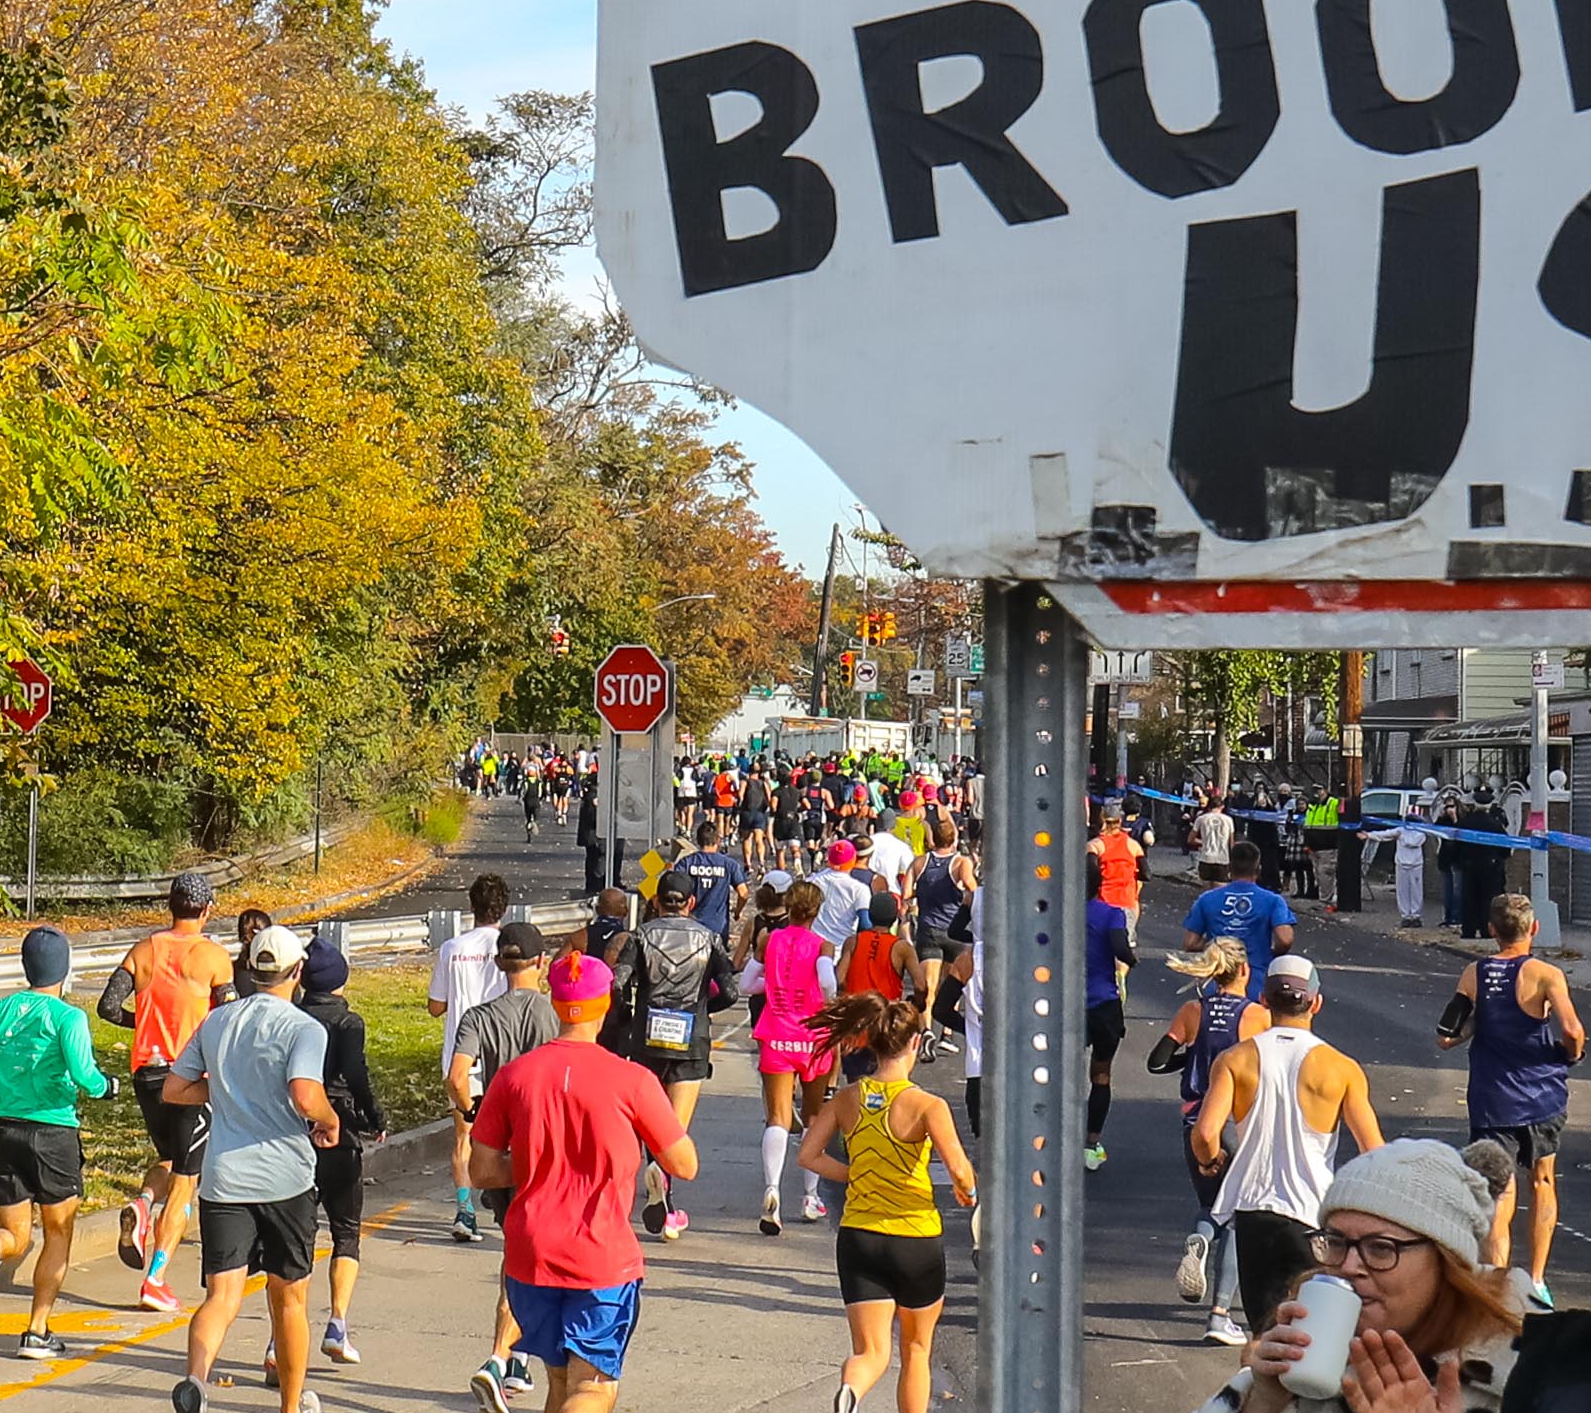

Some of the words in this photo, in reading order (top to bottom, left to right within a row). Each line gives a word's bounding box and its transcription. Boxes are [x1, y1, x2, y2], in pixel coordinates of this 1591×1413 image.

[948, 652, 965, 664] 25
[602, 674, 662, 706] STOP
[1221, 896, 1252, 916] 50
